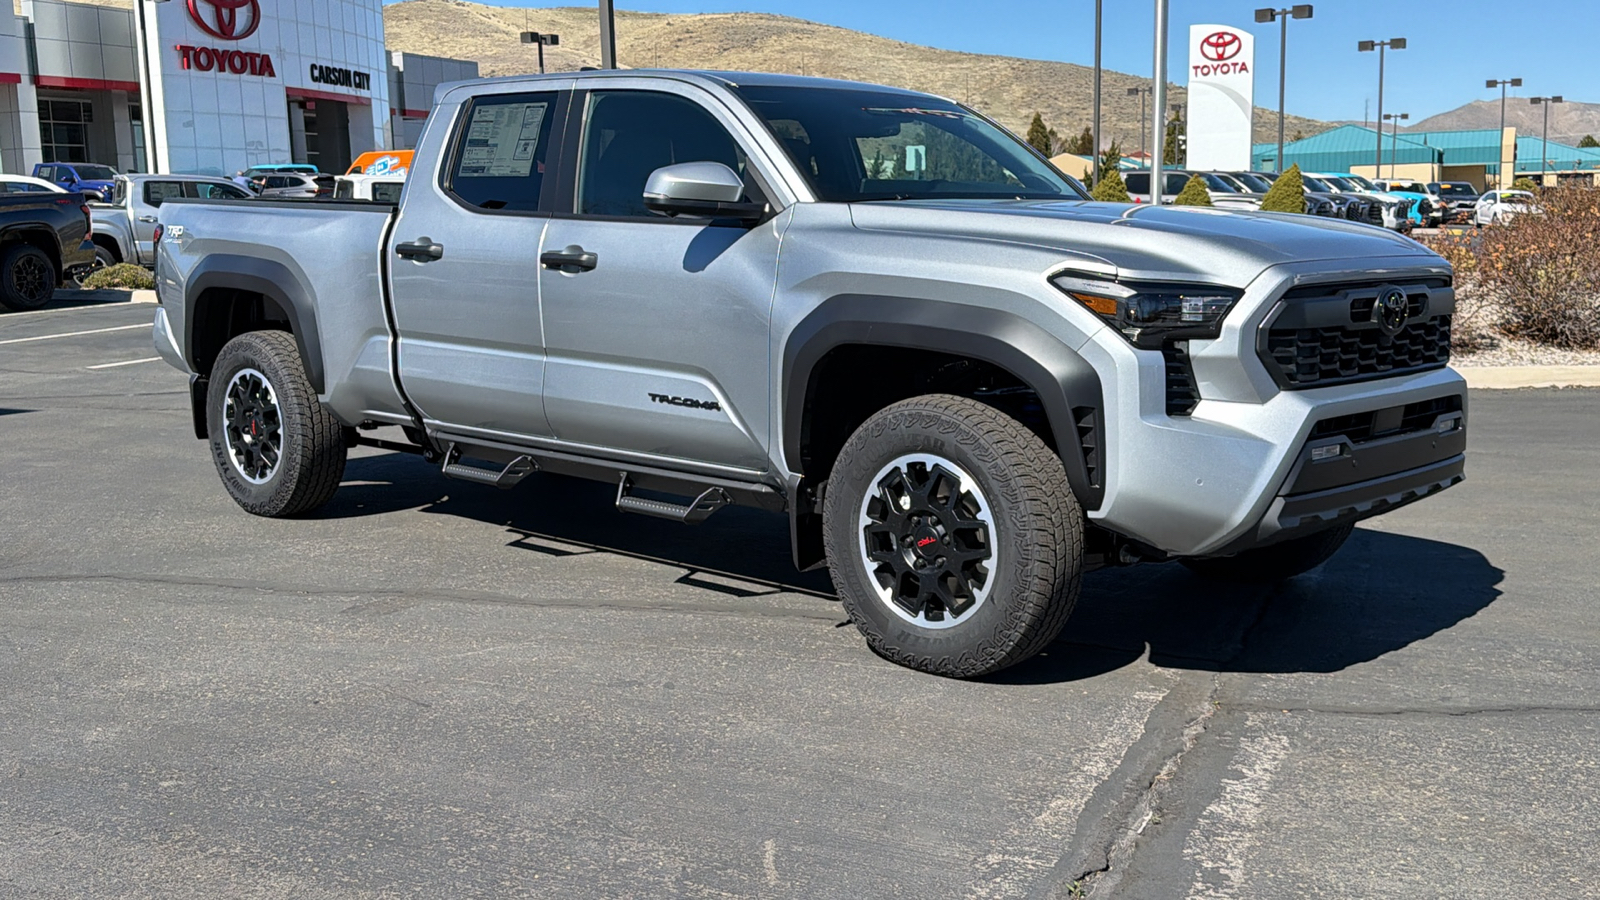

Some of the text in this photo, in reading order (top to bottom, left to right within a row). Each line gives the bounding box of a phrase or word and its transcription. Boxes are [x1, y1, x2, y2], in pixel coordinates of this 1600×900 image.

[176, 44, 276, 78] TOYOTA
[1192, 61, 1249, 78] TOYOTA
[310, 63, 371, 91] CARSON CITY
[167, 225, 184, 238] TRD
[648, 392, 721, 412] TACOMA
